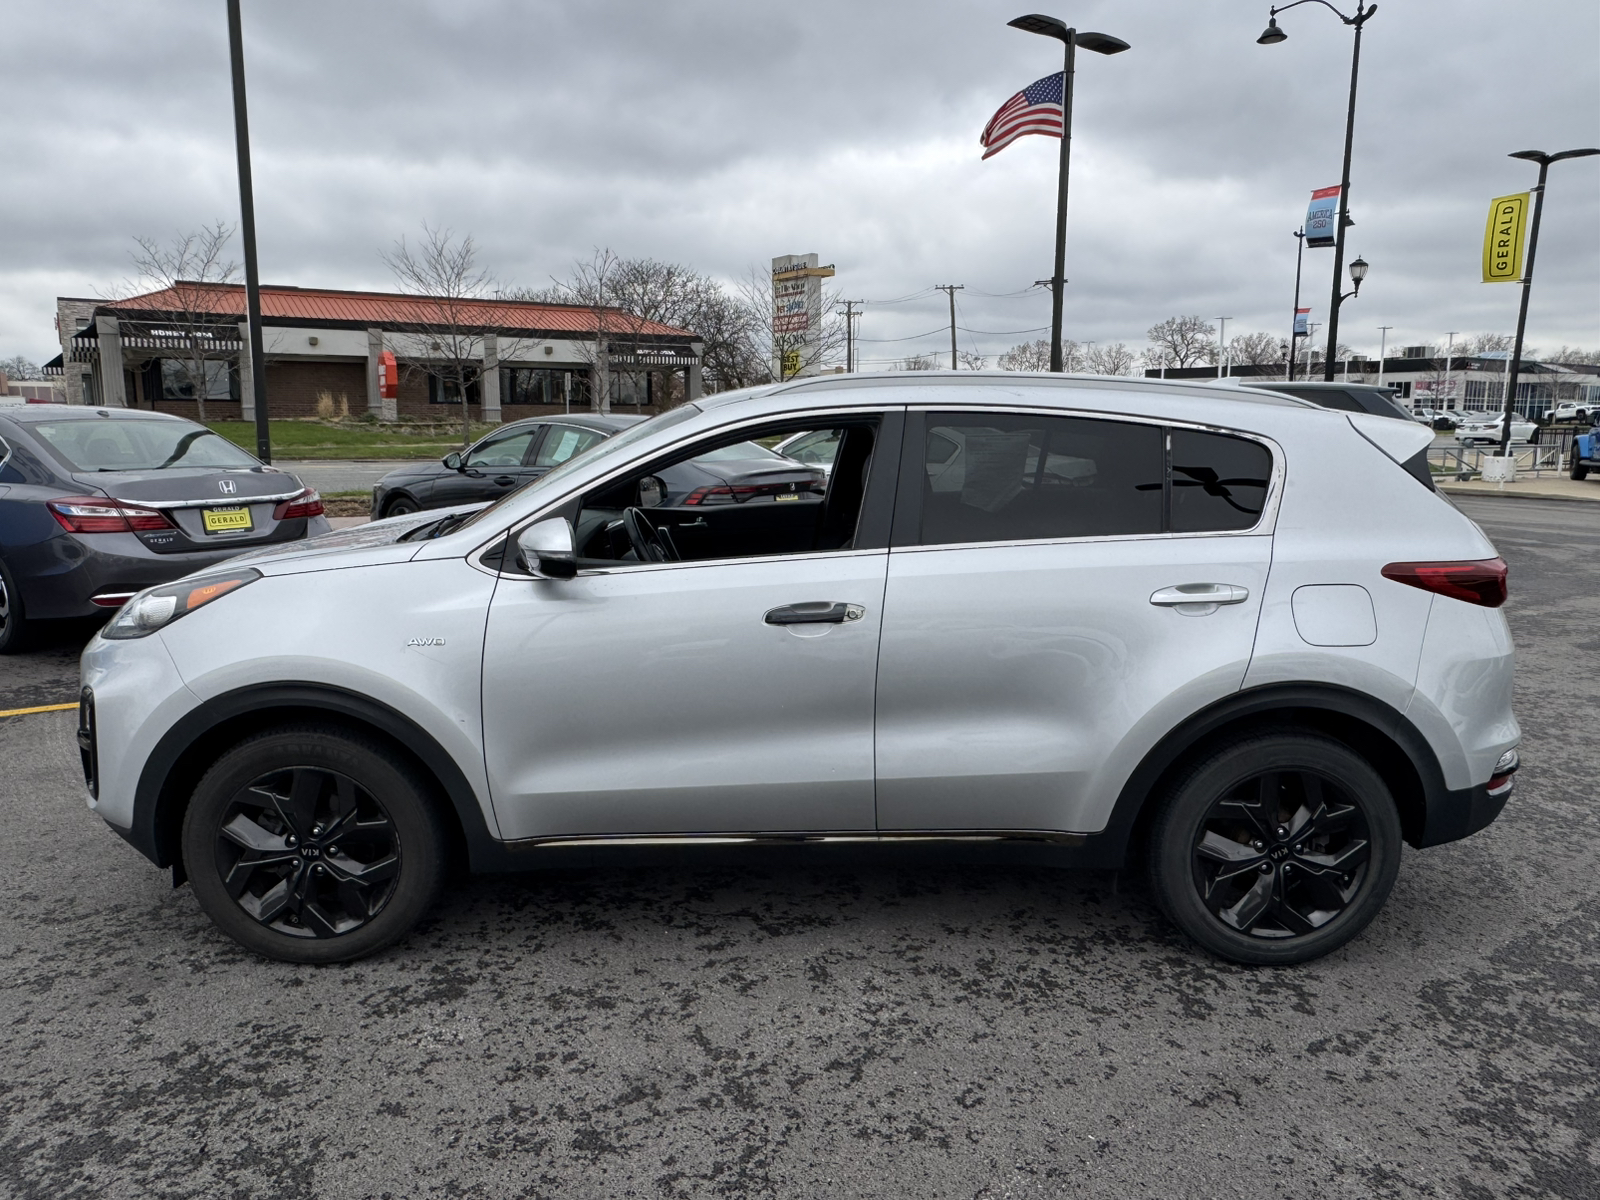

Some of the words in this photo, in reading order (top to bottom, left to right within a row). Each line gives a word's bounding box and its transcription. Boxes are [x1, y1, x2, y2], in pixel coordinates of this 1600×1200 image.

[1306, 209, 1333, 222] AMERICA
[1312, 219, 1326, 229] 250
[1496, 206, 1514, 270] GERALD
[150, 329, 185, 337] HONEY
[783, 363, 797, 371] BUY
[210, 515, 245, 524] GERALD
[407, 637, 446, 647] AWD
[301, 848, 319, 856] KIA
